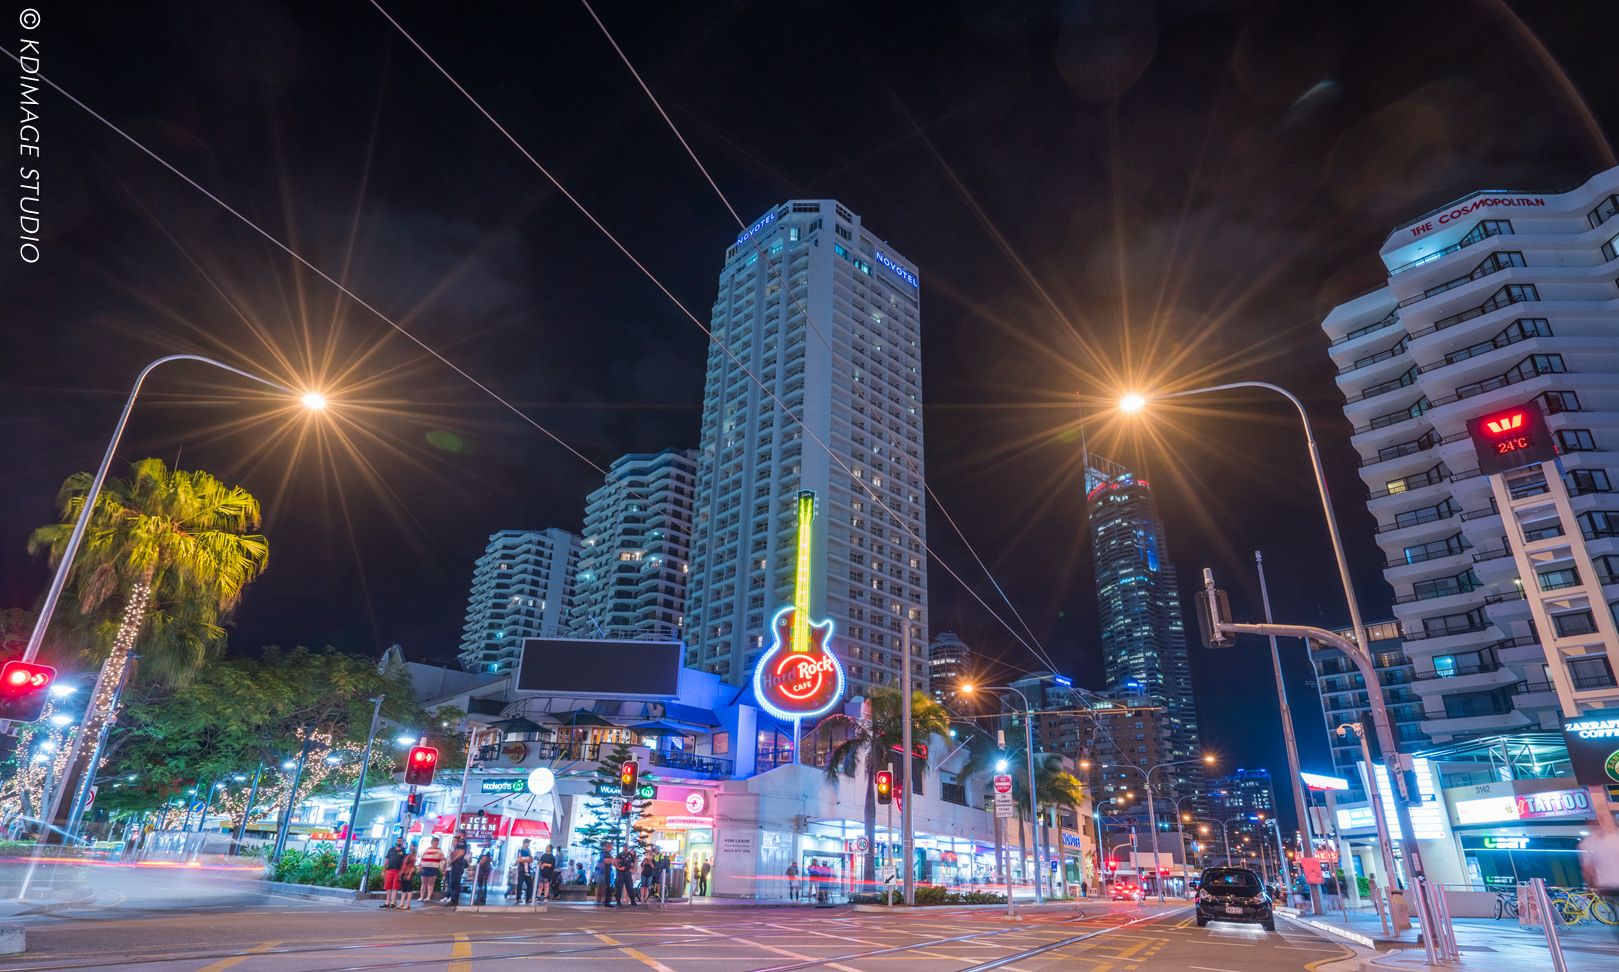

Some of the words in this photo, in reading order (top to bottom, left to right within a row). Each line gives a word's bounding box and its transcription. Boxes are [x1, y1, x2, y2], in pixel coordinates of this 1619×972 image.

[1410, 222, 1433, 237] THE
[1438, 198, 1546, 225] COSMOPOLITAN
[737, 213, 776, 246] NOVOTEL
[876, 251, 918, 288] NOVOTEL
[797, 655, 834, 680] Rock
[792, 680, 812, 692] CAFE
[1525, 792, 1588, 814] TATTOO
[459, 823, 496, 831] CREAM
[469, 816, 488, 824] ICE
